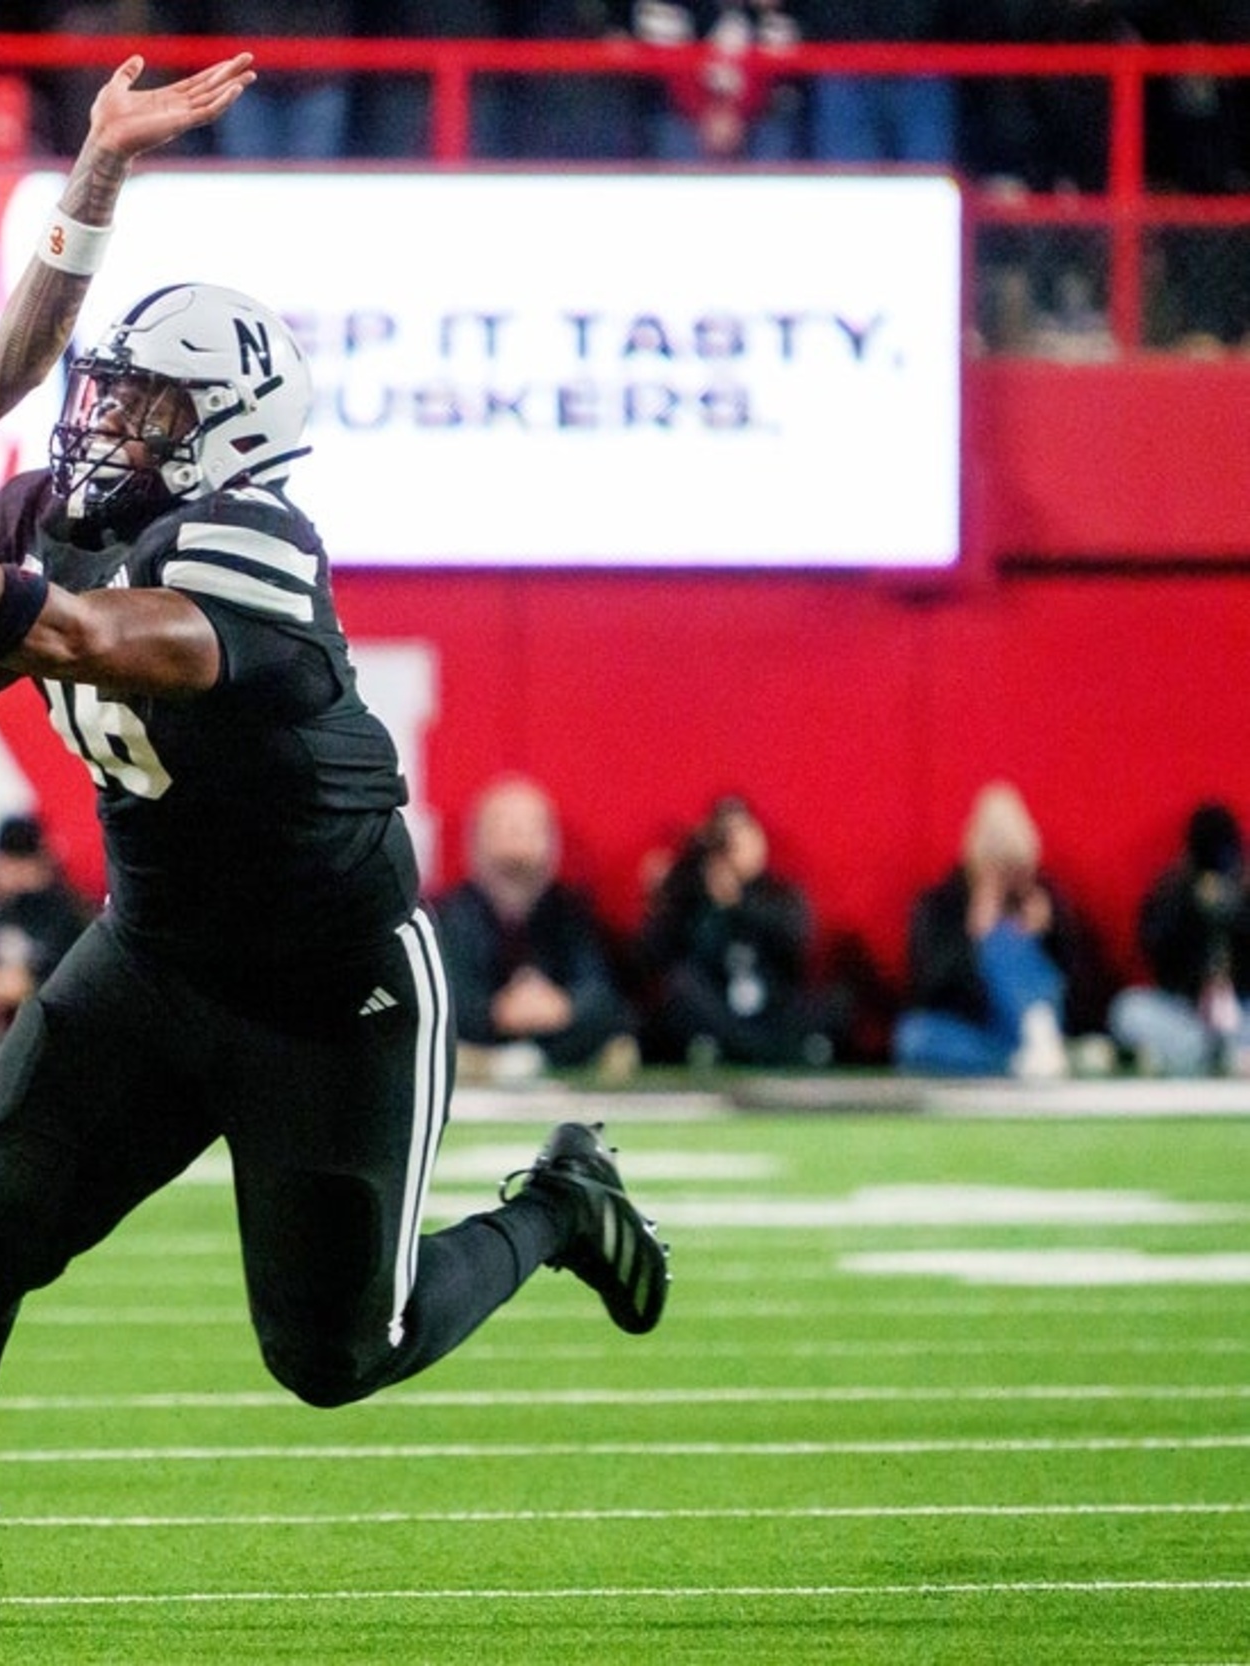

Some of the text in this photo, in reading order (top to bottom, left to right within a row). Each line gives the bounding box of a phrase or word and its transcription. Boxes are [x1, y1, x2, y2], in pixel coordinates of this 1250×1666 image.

[232, 317, 272, 377] N
[282, 310, 398, 359] EP
[440, 310, 515, 360] IT
[312, 383, 784, 434] USKERS.
